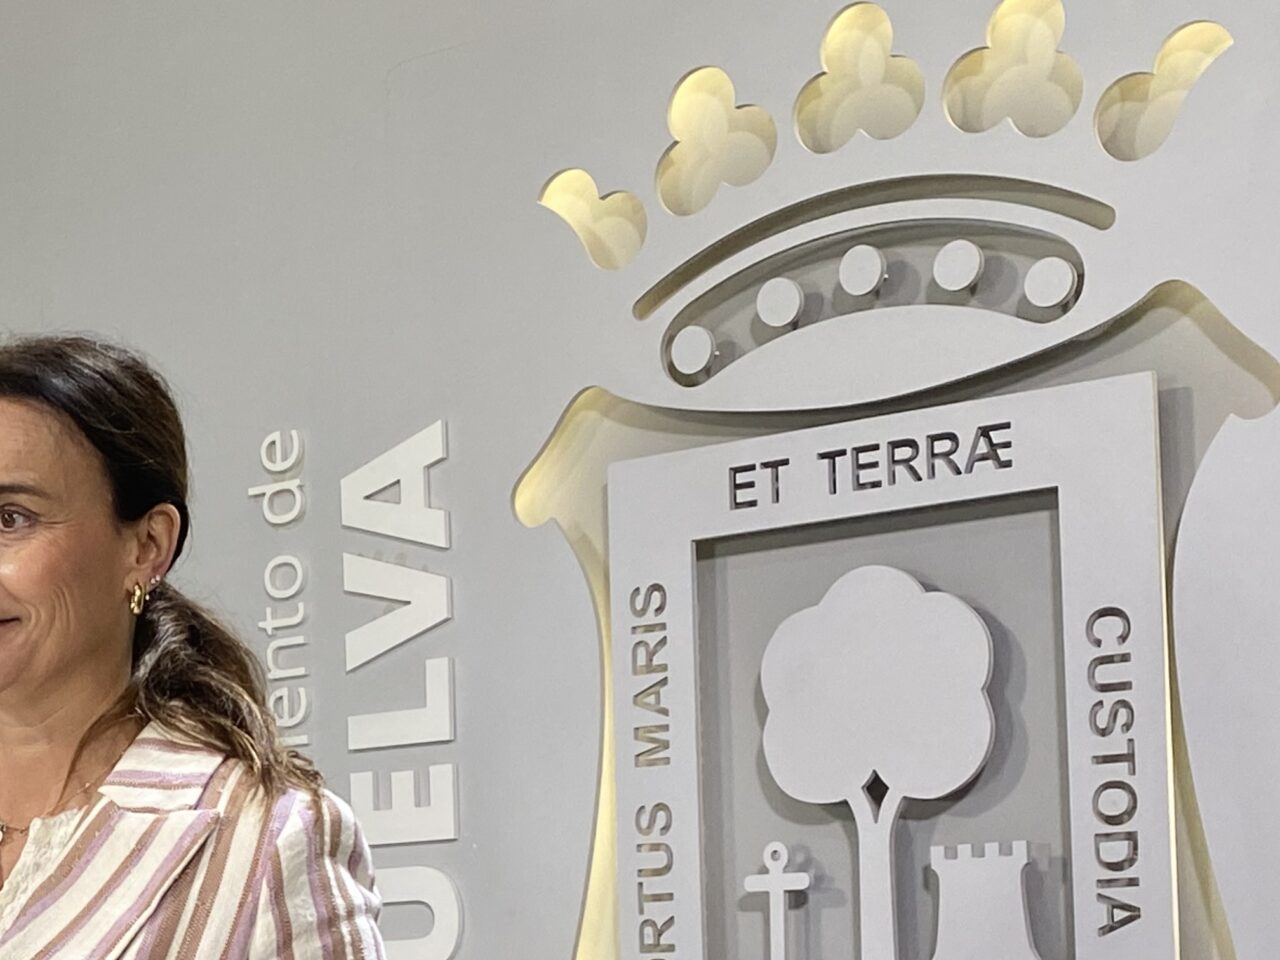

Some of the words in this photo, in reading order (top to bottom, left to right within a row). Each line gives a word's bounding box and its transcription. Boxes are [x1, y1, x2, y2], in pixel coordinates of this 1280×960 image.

[248, 428, 307, 526] de
[728, 457, 790, 510] ET
[629, 581, 671, 767] MARIS
[1085, 605, 1142, 938] CUSTODIA
